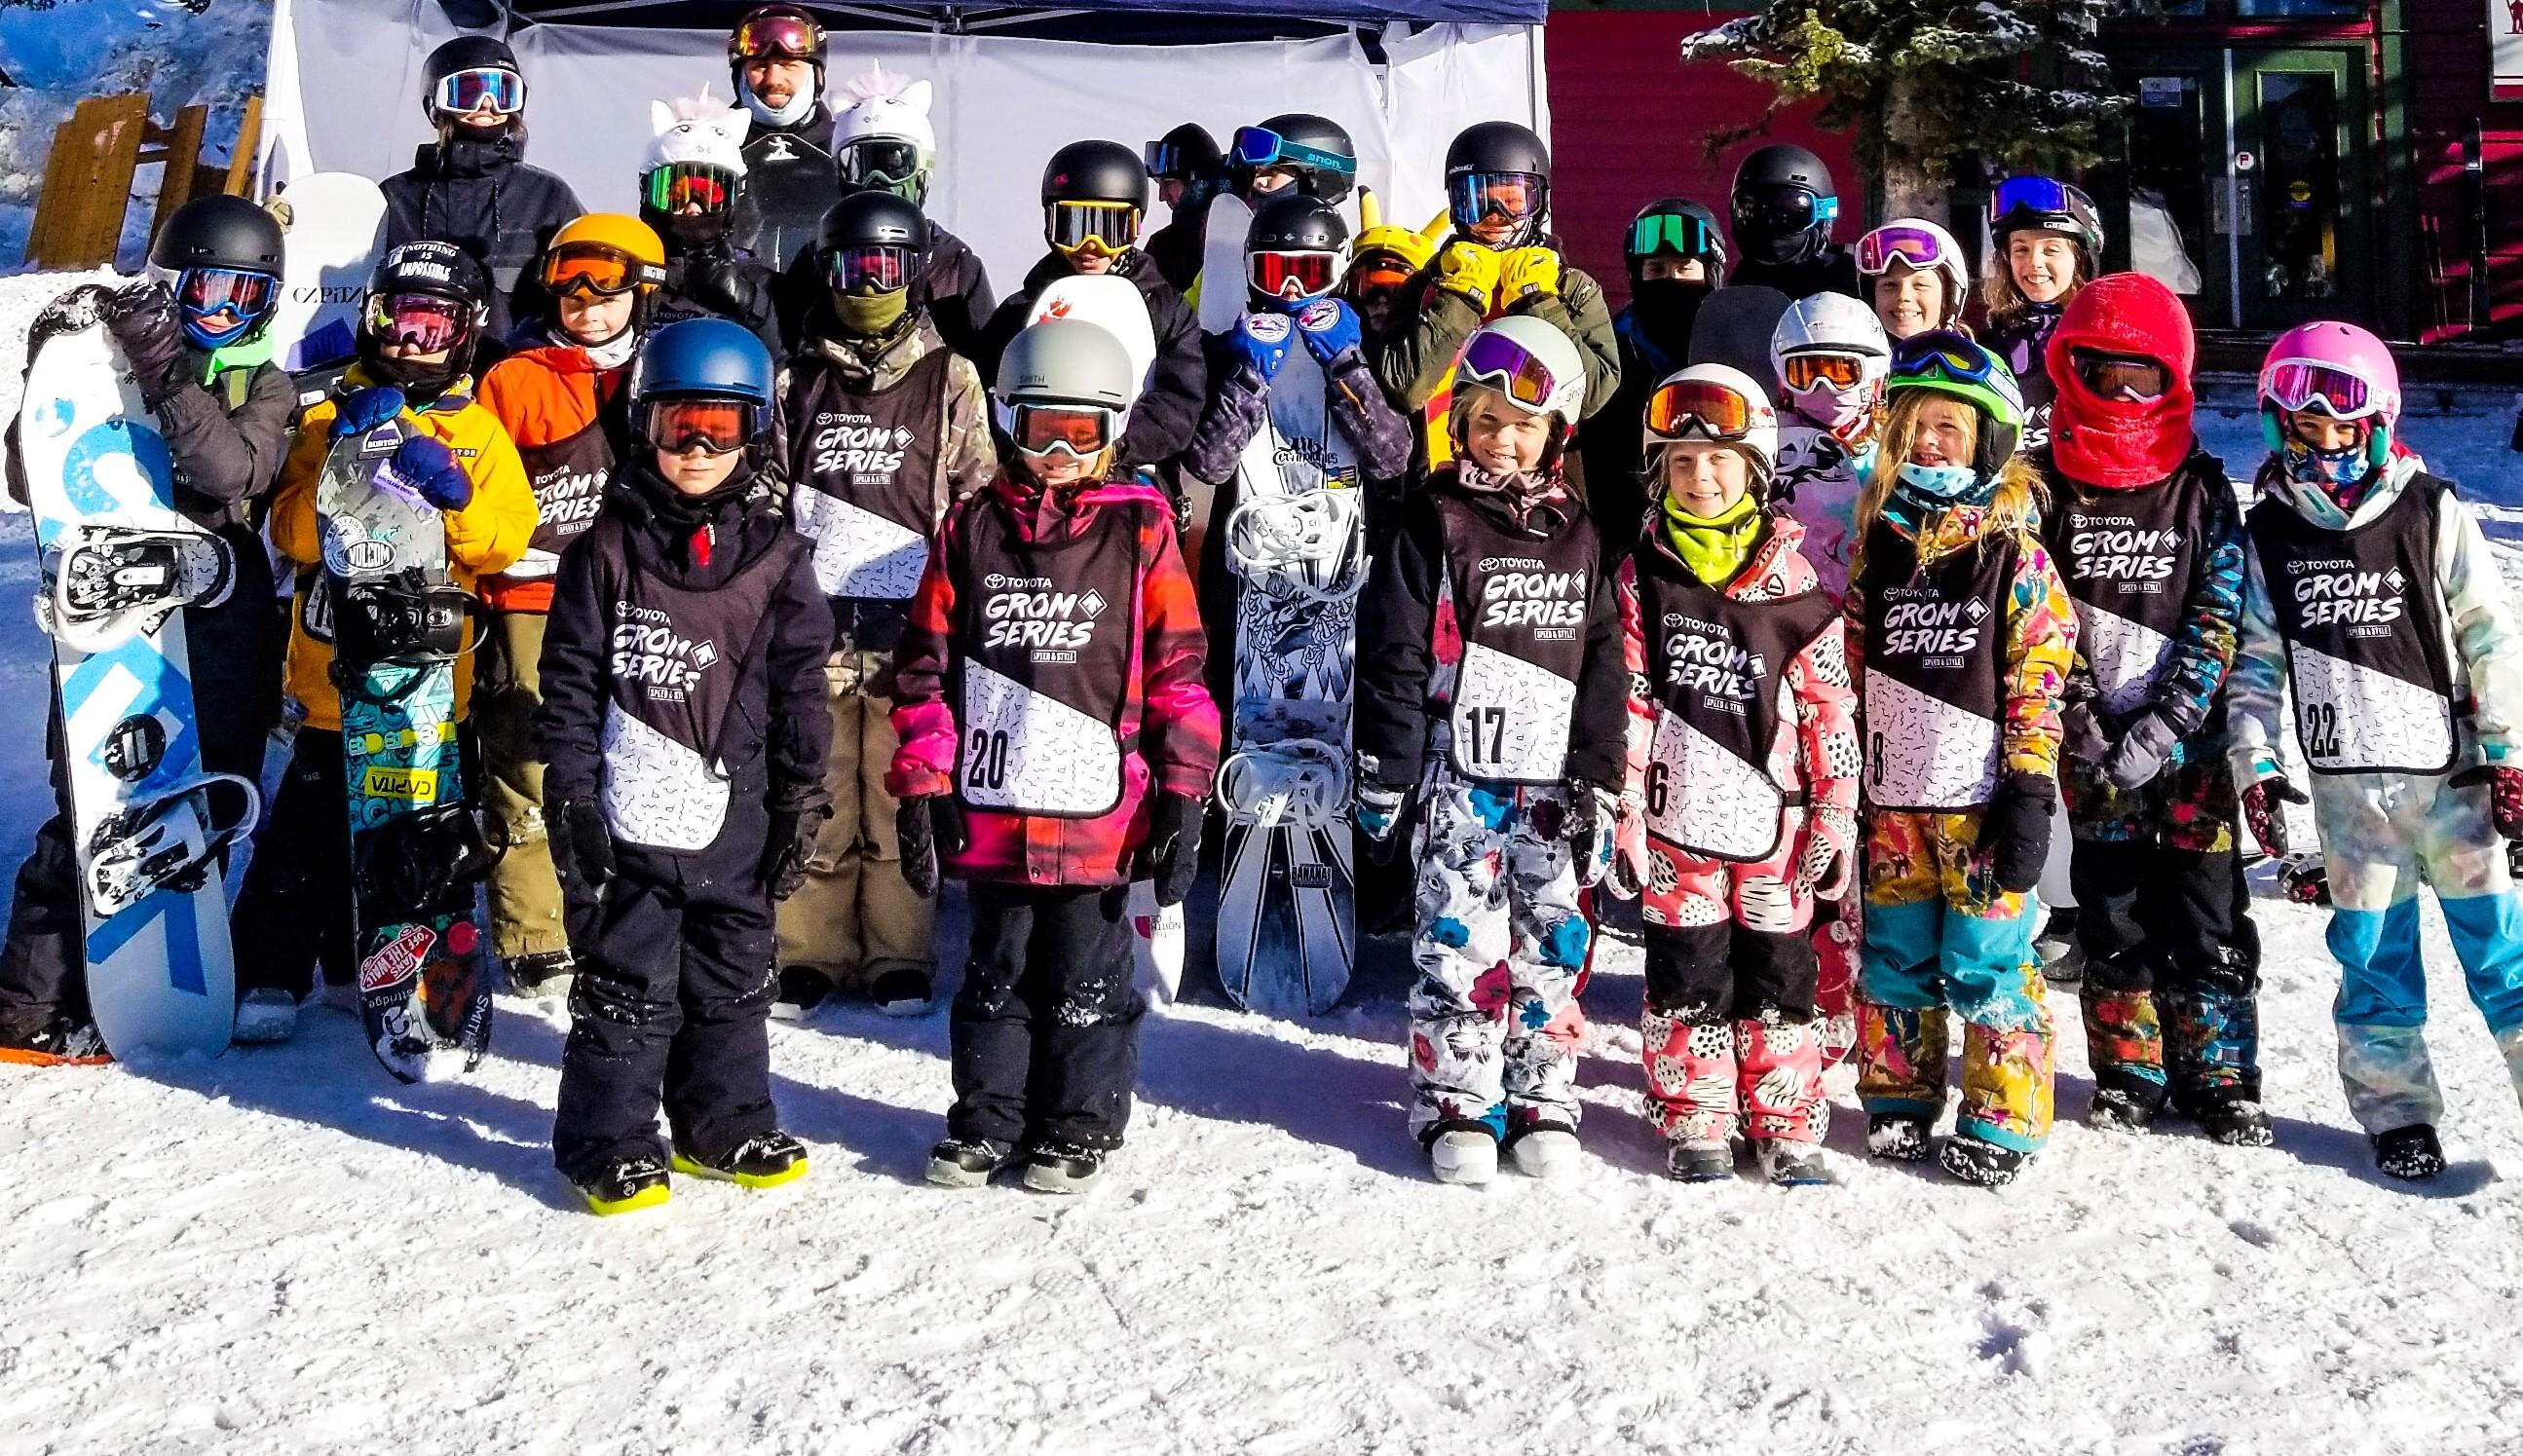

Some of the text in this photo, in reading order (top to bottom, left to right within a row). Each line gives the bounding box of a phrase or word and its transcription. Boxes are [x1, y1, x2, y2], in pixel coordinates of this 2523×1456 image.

[402, 243, 457, 257] NOTHING
[422, 251, 433, 260] IS
[399, 261, 452, 281] IMPOSSIBLE
[833, 413, 873, 425] TOYOTA
[814, 426, 891, 450] GROM
[813, 449, 905, 473] SERIES
[537, 495, 603, 527] ERIES
[2088, 515, 2136, 527] TOYOTA
[348, 541, 391, 570] VOLCOM
[2070, 529, 2161, 555] GROM
[1499, 557, 1546, 570] TOYOTA
[2070, 553, 2176, 580] SERIES
[2306, 559, 2355, 572] TOYOTA
[1006, 577, 1053, 588] TOYOTA
[1484, 573, 1570, 601] GROM
[2294, 572, 2382, 603] GROM
[985, 592, 1078, 619] GROM
[1482, 599, 1586, 628] SERIES
[1882, 602, 1962, 628] GROM
[2300, 596, 2403, 629] SERIES
[613, 623, 693, 657] GROM
[984, 620, 1096, 649] SERIES
[1684, 616, 1730, 639] TOYOTA
[1882, 627, 1979, 656] SERIES
[1665, 633, 1748, 671] GROM
[612, 651, 701, 692] SERIES
[1665, 659, 1756, 701] SERIES
[1466, 706, 1506, 765] 17
[2307, 701, 2340, 759] 22
[967, 728, 1009, 790] 20
[1647, 761, 1670, 818] 6
